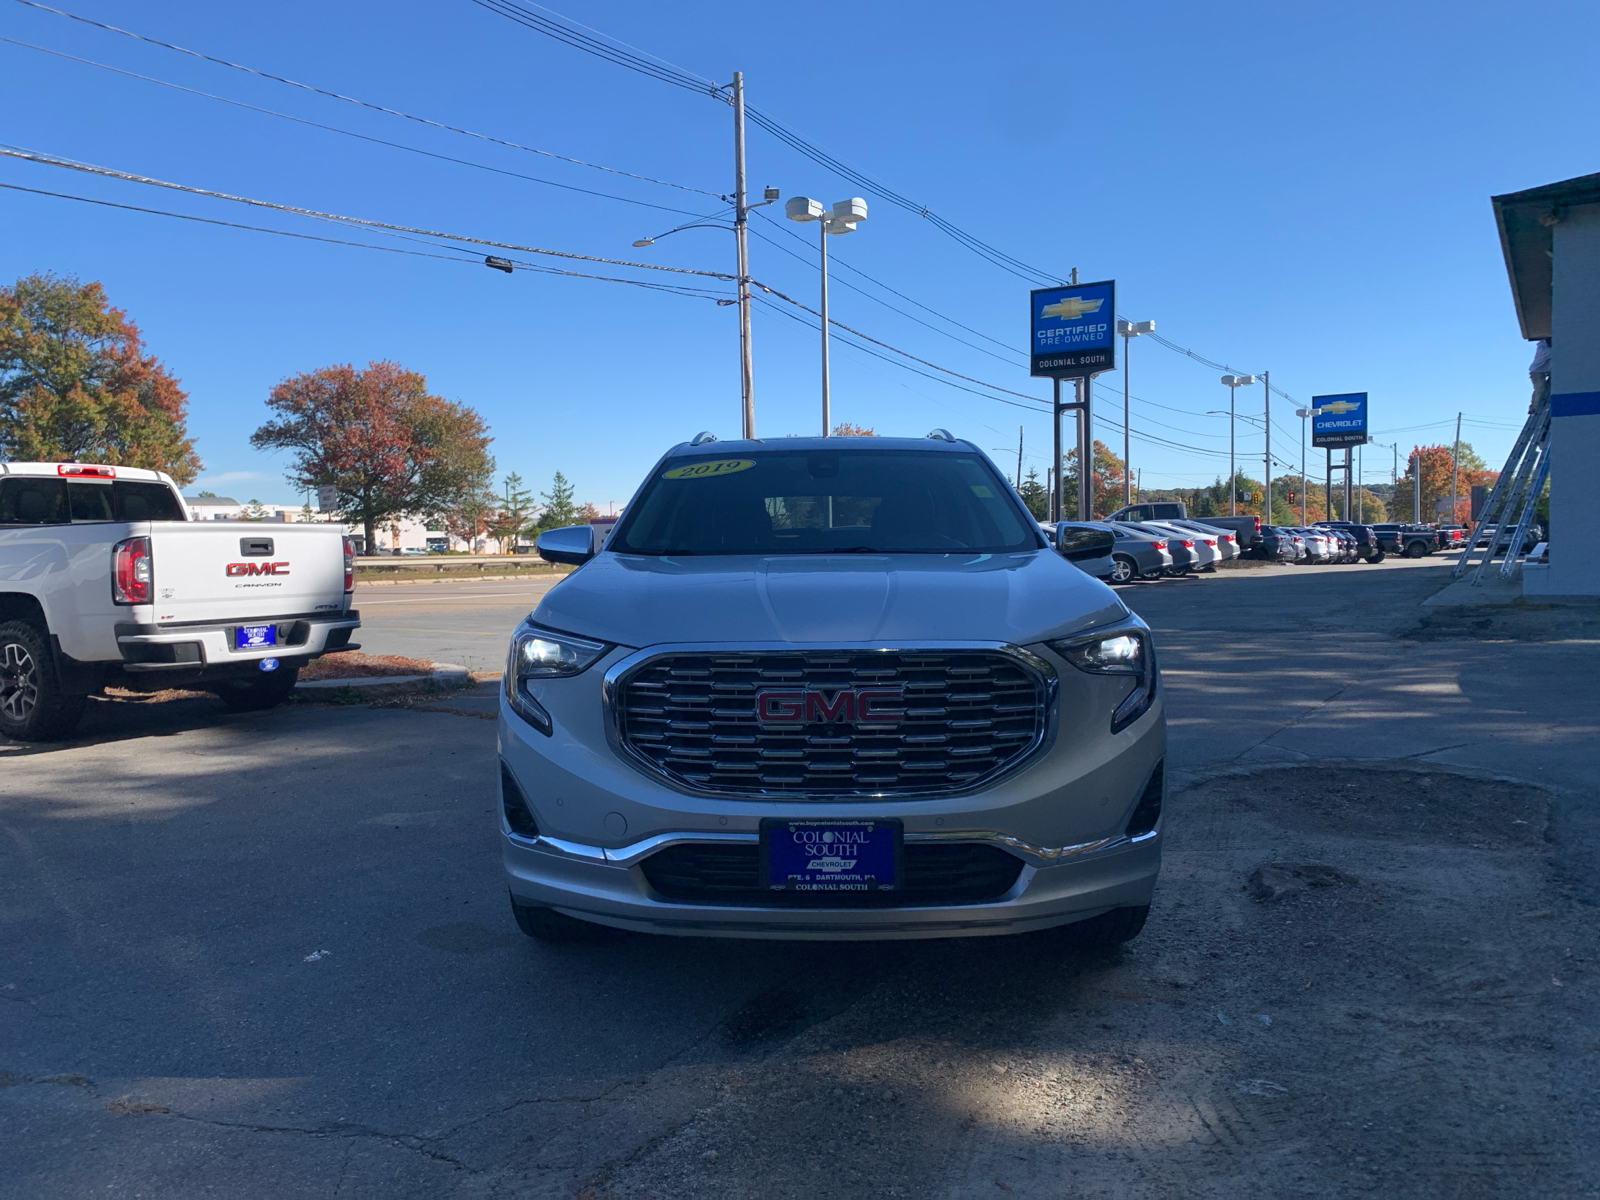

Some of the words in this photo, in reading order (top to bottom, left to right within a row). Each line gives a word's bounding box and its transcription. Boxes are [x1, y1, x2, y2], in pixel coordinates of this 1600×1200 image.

[1037, 323, 1107, 338] CERTIFIED
[1040, 332, 1104, 346] PRE-OWNED
[1039, 358, 1076, 368] COLONIAL
[1080, 355, 1105, 364] SOUTH
[1316, 420, 1362, 429] CHEVROLET
[679, 461, 741, 478] 2019
[226, 561, 291, 577] GMC
[757, 688, 905, 724] GMC
[793, 831, 870, 844] COLONIAL
[805, 843, 858, 856] SOUTH
[816, 874, 863, 882] DARTMOUTH,
